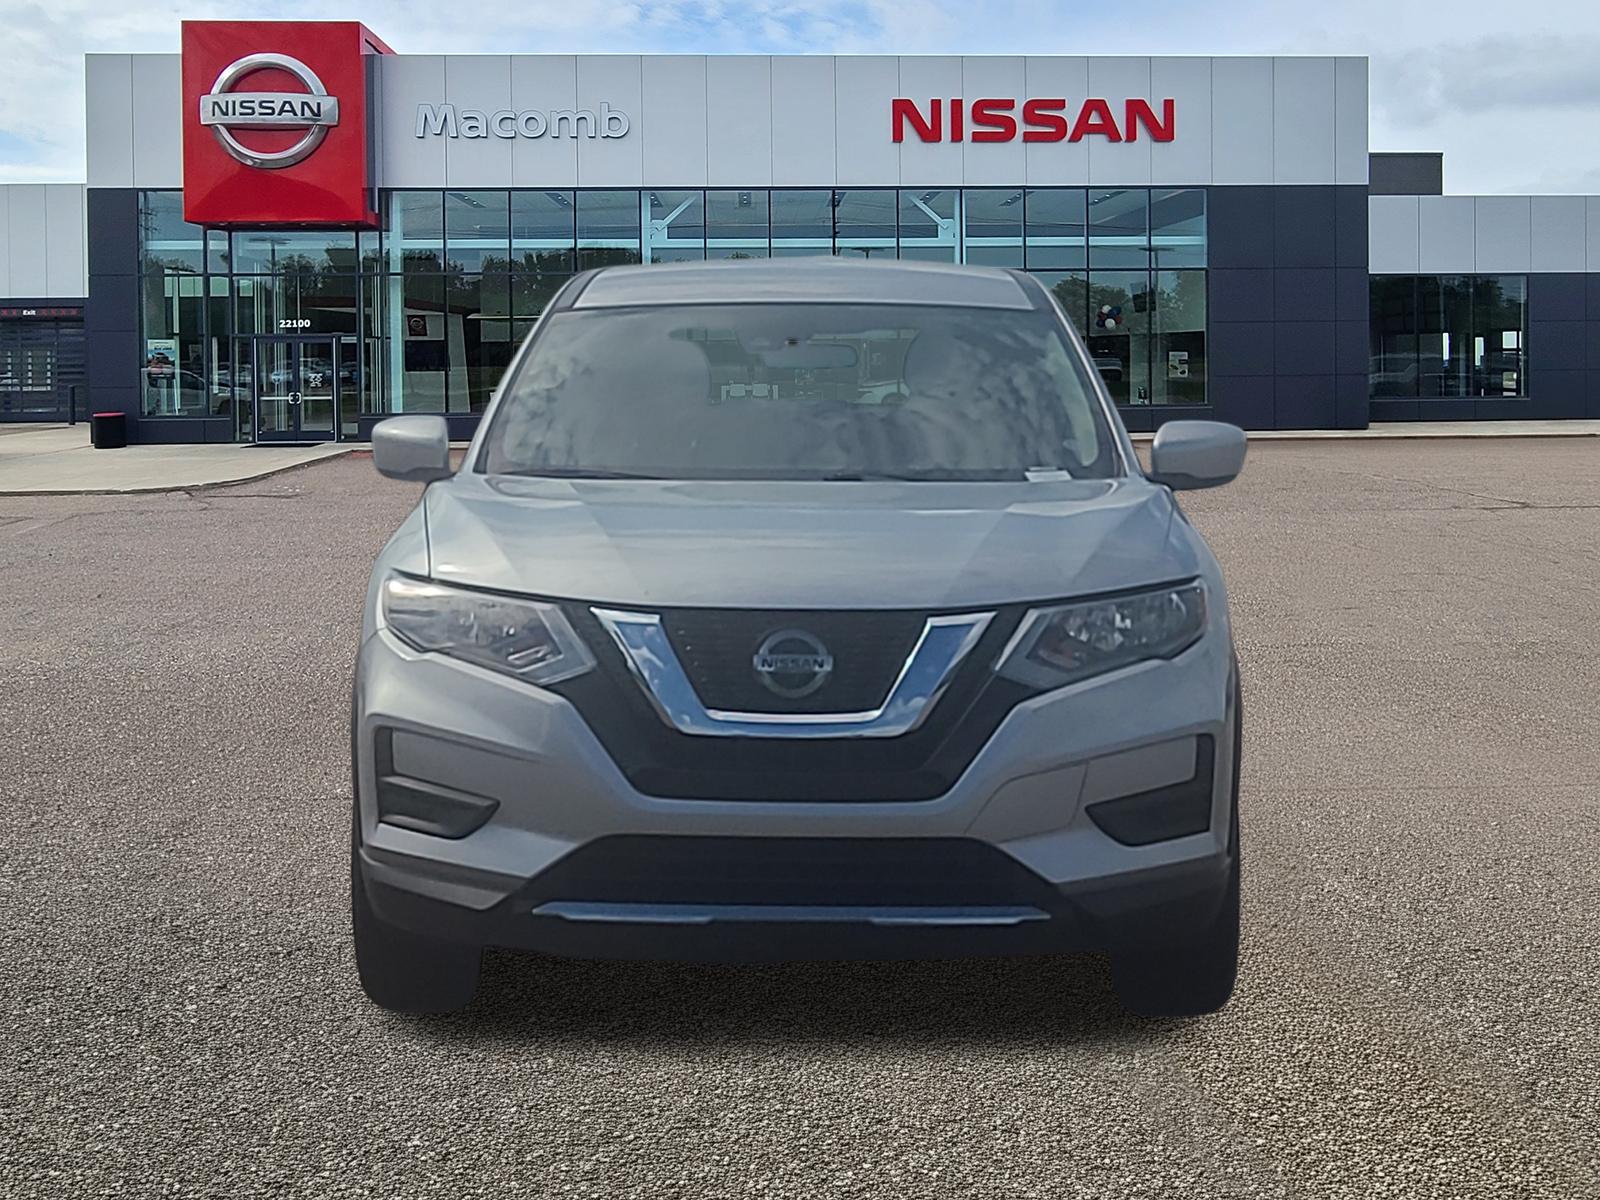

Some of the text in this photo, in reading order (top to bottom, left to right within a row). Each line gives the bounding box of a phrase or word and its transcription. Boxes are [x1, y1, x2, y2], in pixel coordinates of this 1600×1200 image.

[211, 100, 322, 118] NISSAN
[415, 101, 631, 139] Macomb
[891, 98, 1176, 143] NISSAN
[279, 319, 311, 328] 22100
[760, 658, 825, 670] NISSAN
